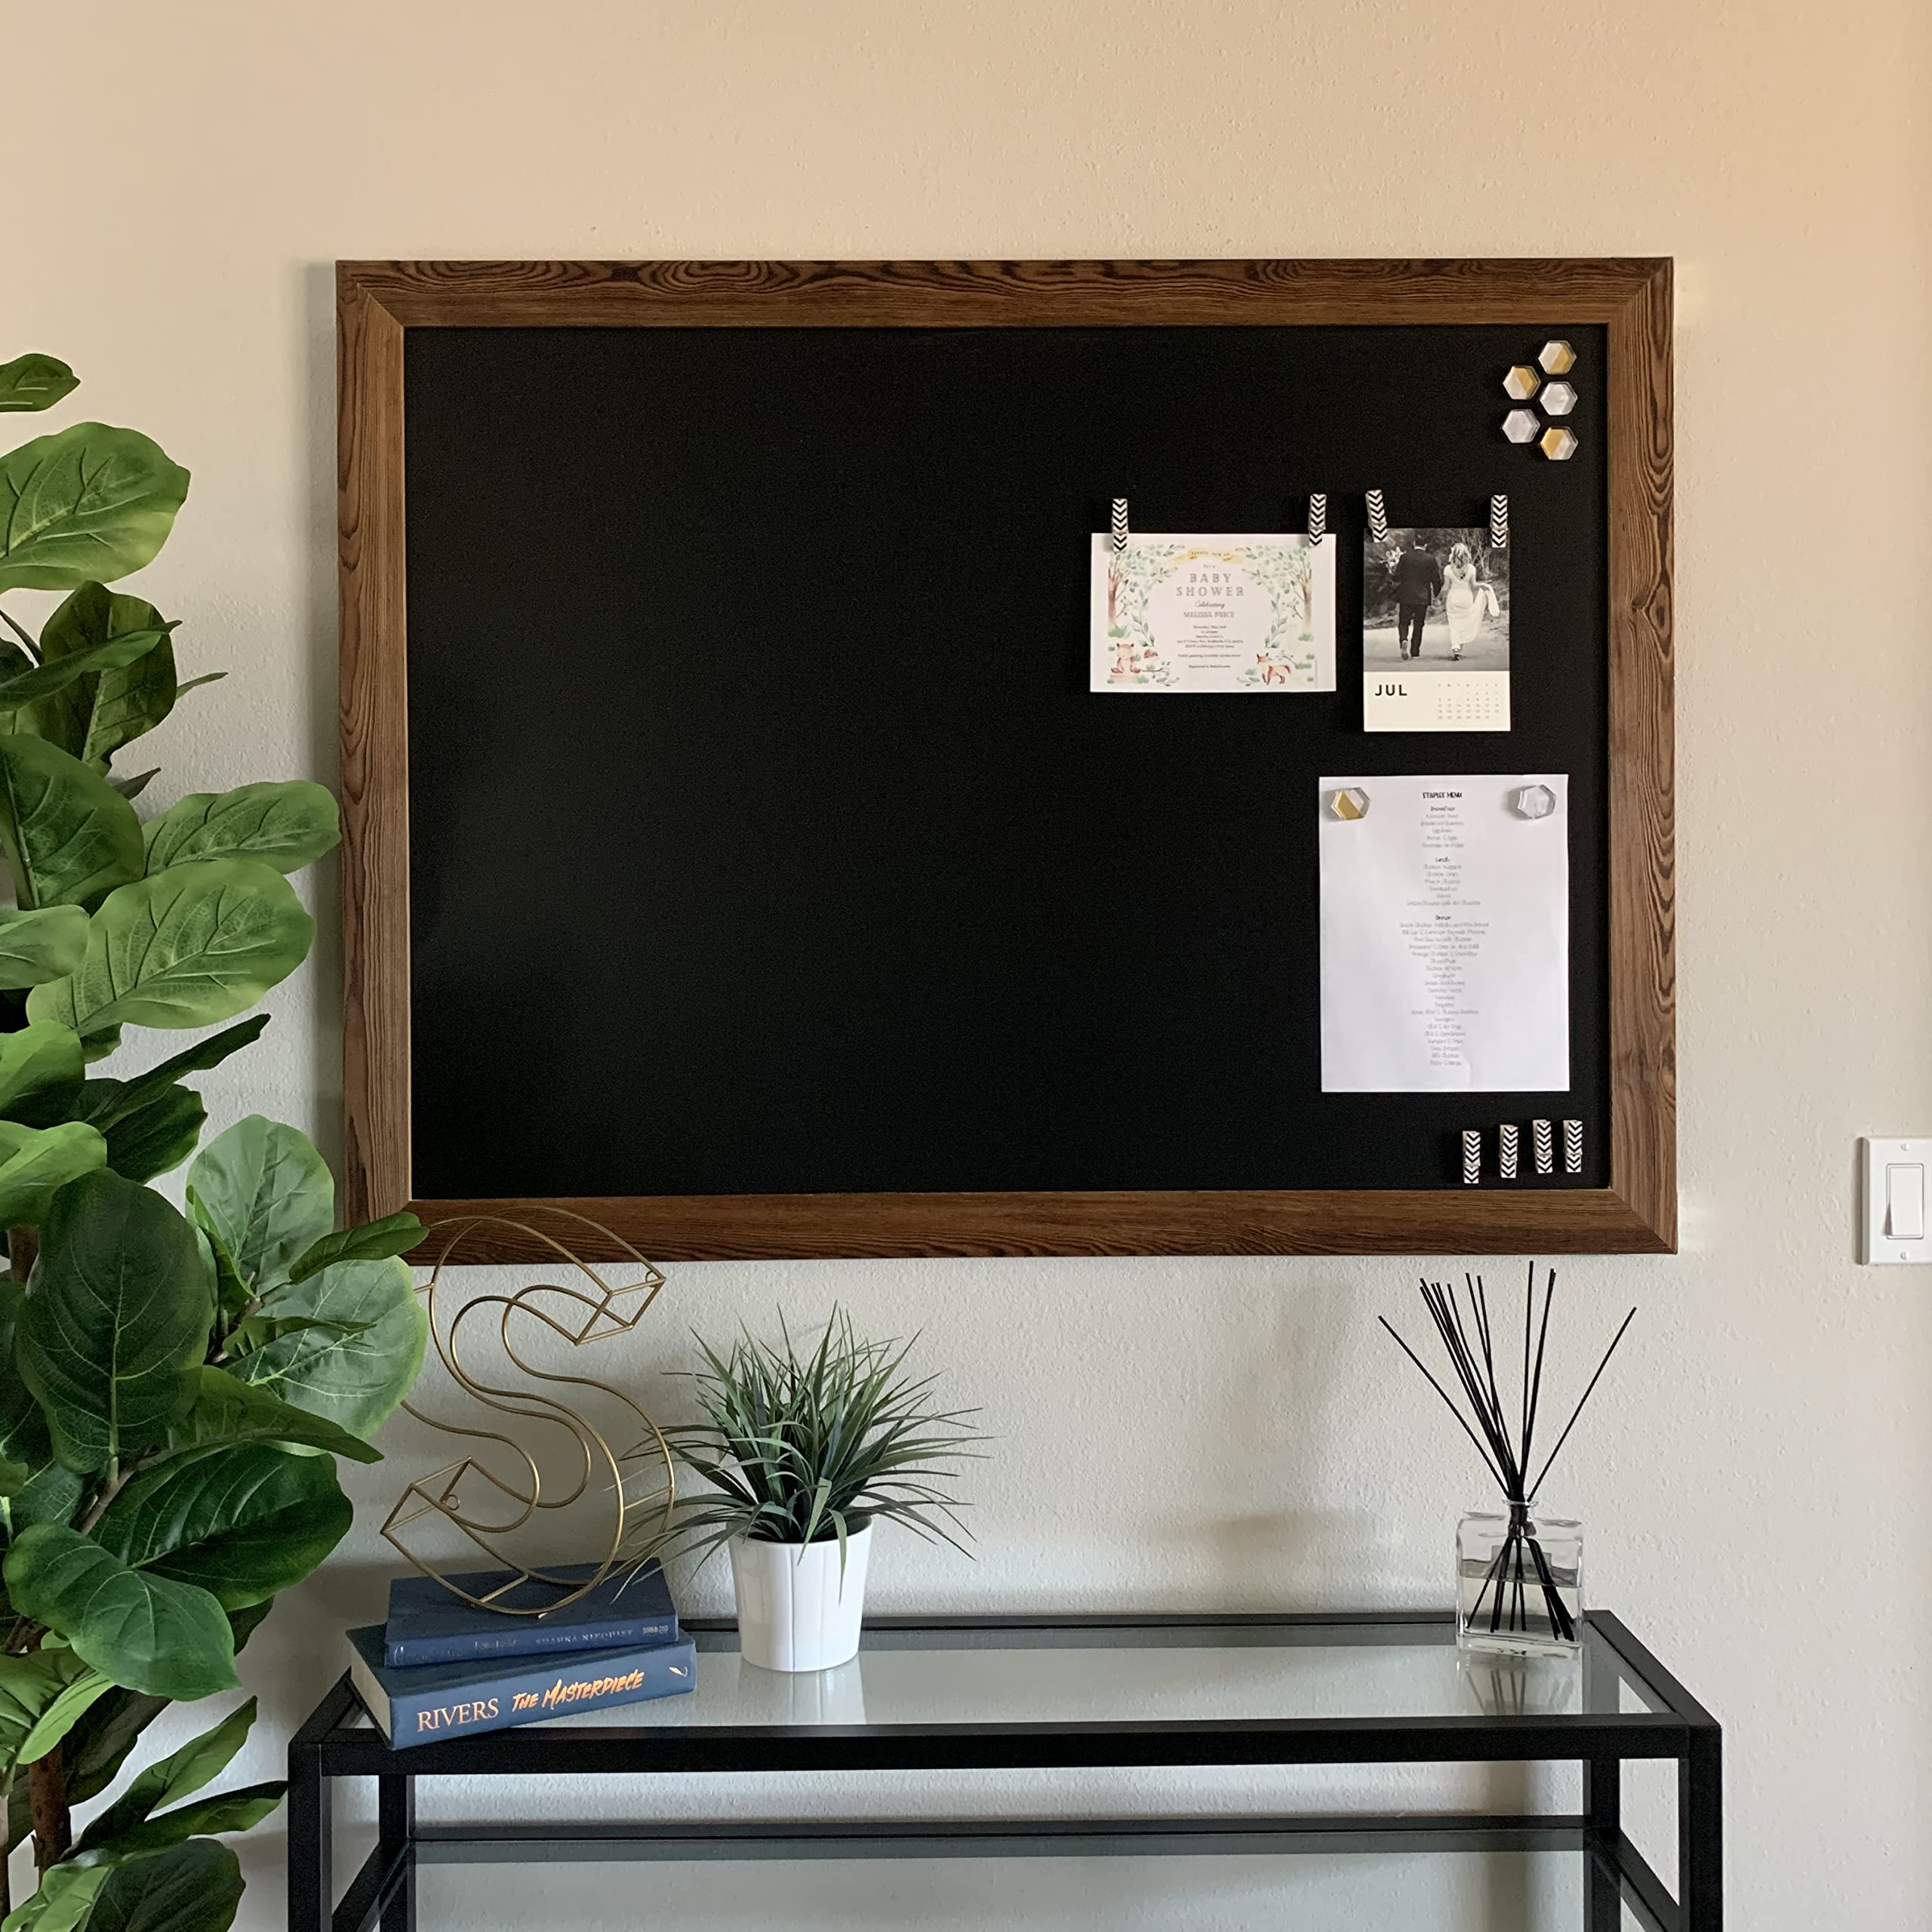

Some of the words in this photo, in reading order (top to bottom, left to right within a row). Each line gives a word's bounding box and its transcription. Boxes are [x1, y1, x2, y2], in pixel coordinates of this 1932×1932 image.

[1189, 573, 1232, 583] BABY
[1176, 586, 1244, 597] SHOWER
[1374, 684, 1407, 697] JUL
[417, 1698, 500, 1733] RIVERS
[512, 1692, 540, 1712] THE
[542, 1669, 645, 1710] MASTERPIECE
